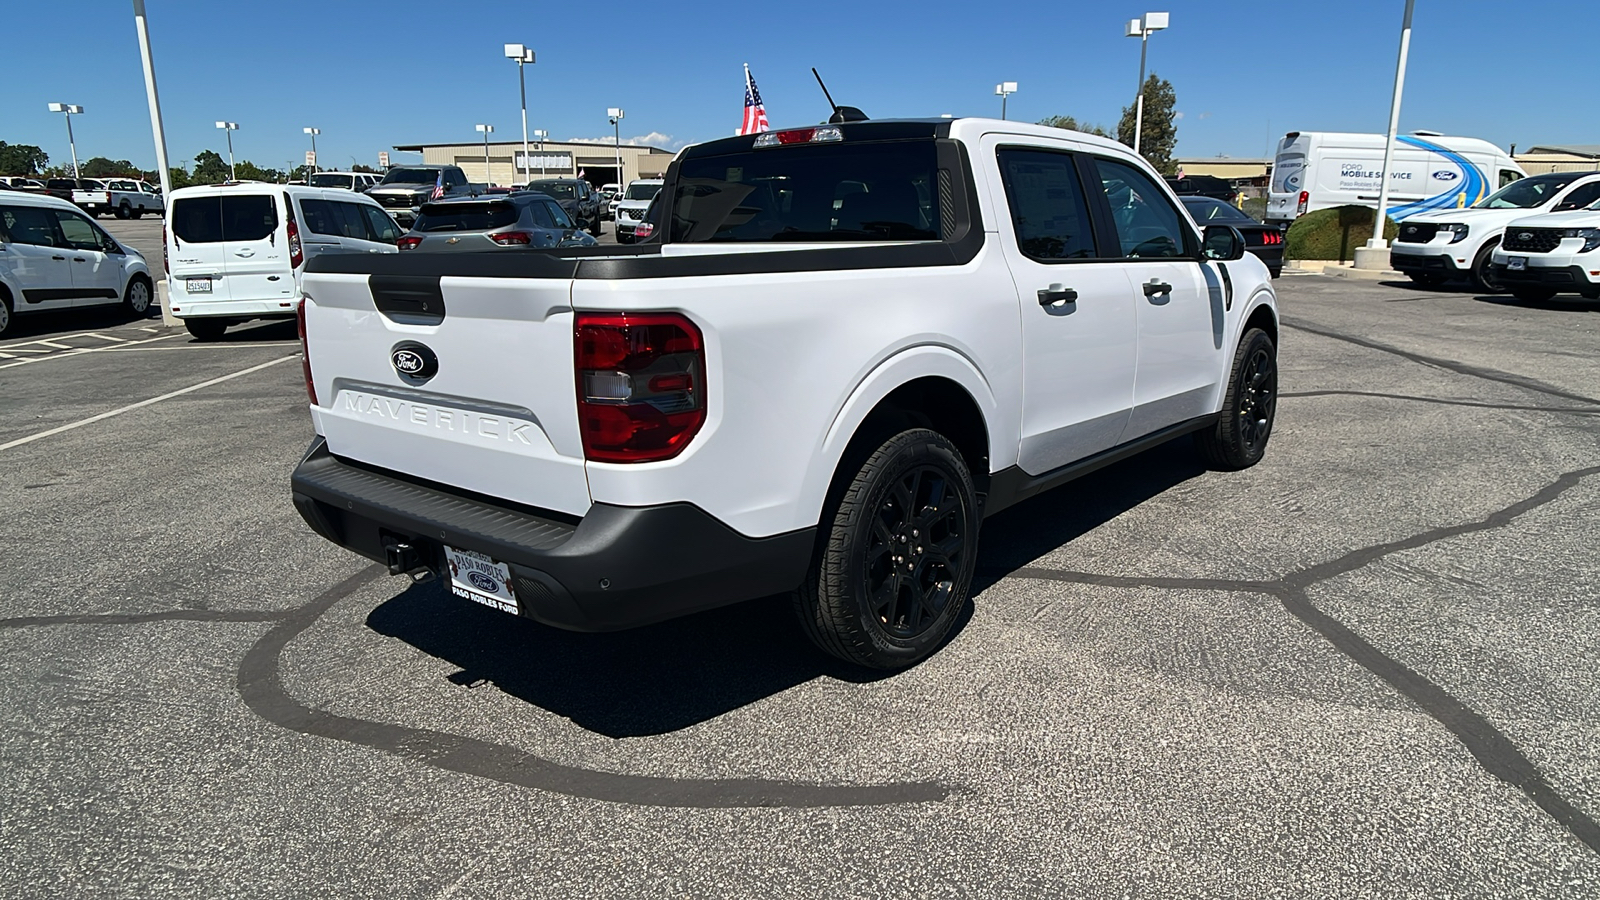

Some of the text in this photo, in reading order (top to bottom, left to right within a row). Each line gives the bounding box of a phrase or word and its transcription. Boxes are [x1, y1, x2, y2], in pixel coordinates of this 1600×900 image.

[1341, 163, 1363, 171] FORD
[1375, 171, 1412, 180] SVICE
[1435, 171, 1455, 180] Ford
[397, 352, 418, 370] Ford
[344, 392, 532, 446] MAVERICK
[454, 554, 474, 571] PASO
[474, 561, 507, 585] ROBLES
[474, 574, 494, 590] Ford
[451, 586, 519, 616] PASO ROBLES FORD
